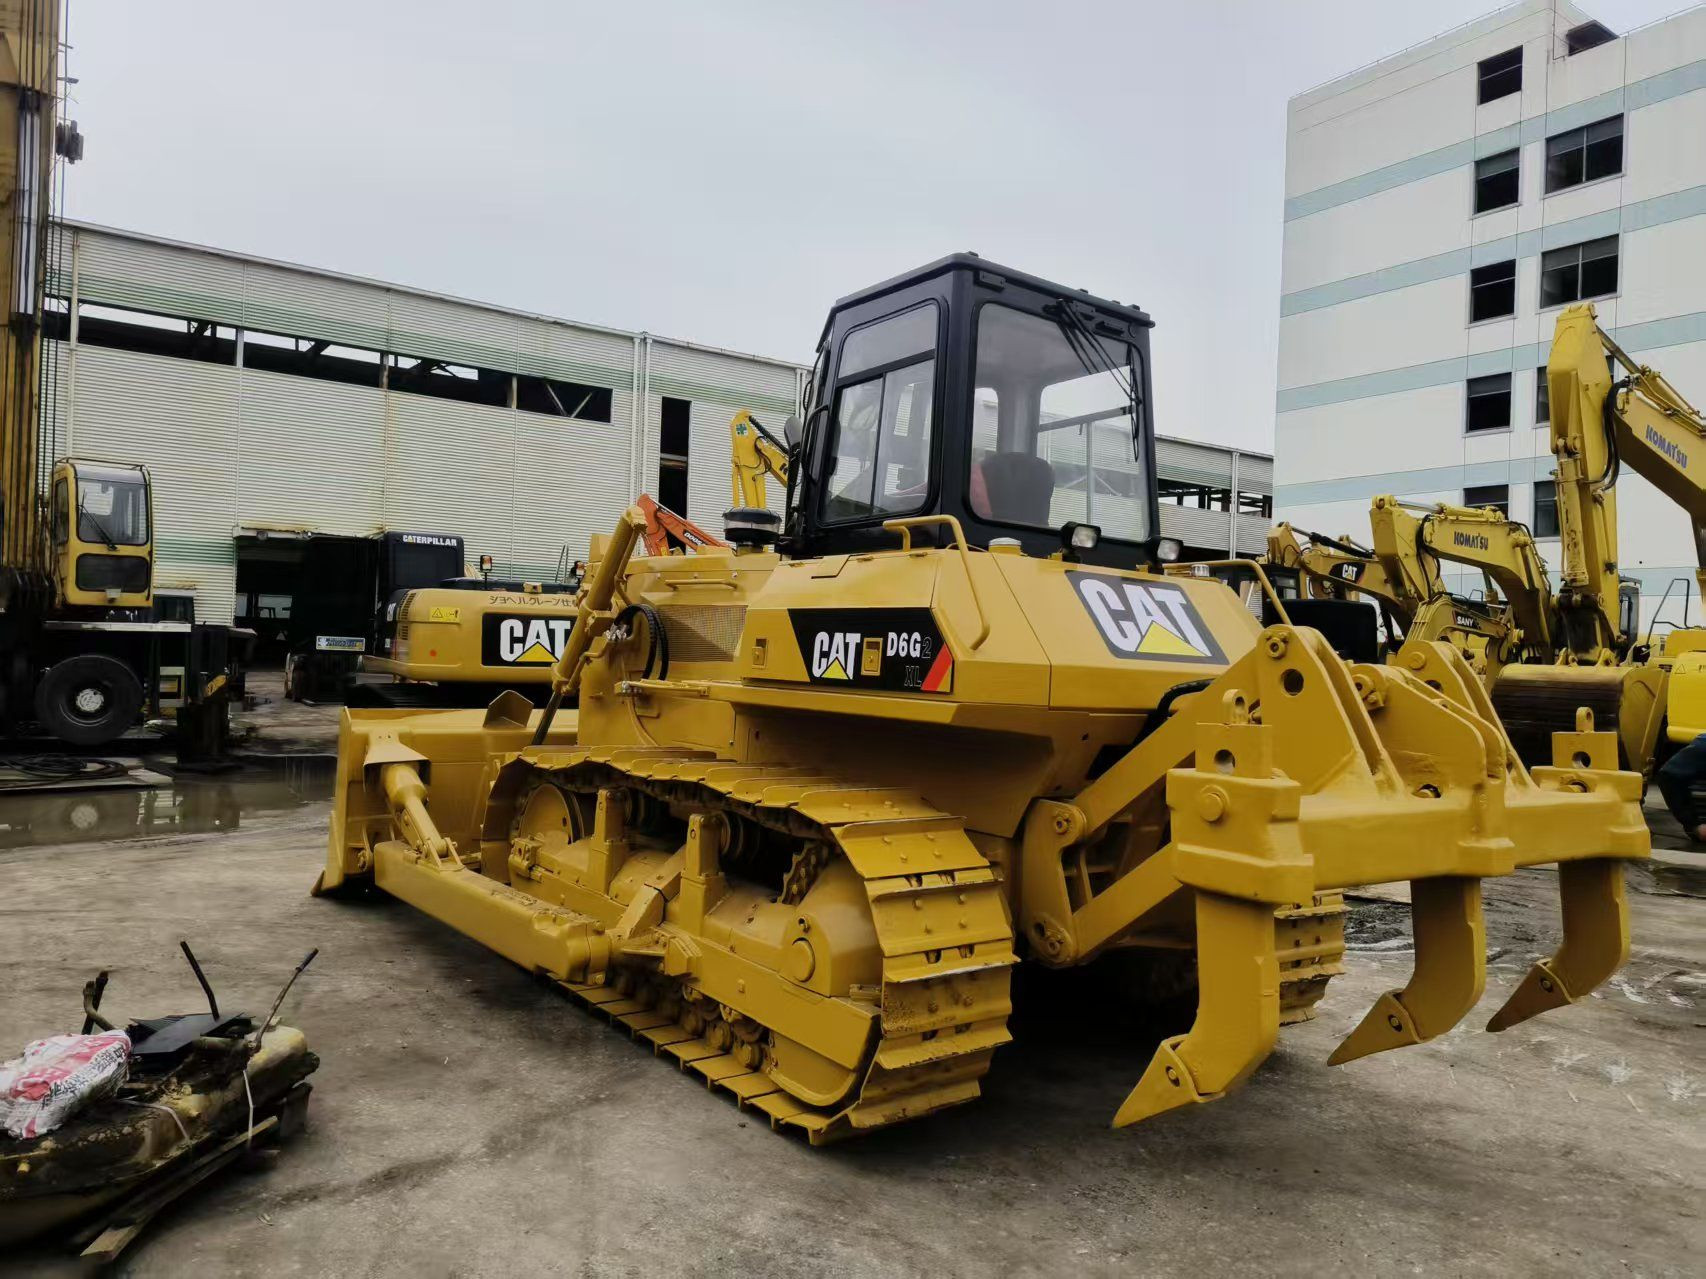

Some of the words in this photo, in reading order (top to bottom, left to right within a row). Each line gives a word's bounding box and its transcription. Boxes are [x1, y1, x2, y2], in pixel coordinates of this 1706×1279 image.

[1646, 424, 1688, 469] KOMATSU
[402, 534, 457, 547] CATERPILLAR
[1453, 530, 1489, 551] KOMATSU
[1342, 564, 1357, 581] CAT
[1079, 578, 1212, 657] CAT
[1456, 615, 1474, 627] SANY
[500, 618, 571, 662] CAT
[812, 631, 861, 680] CAT
[904, 665, 922, 687] XL
